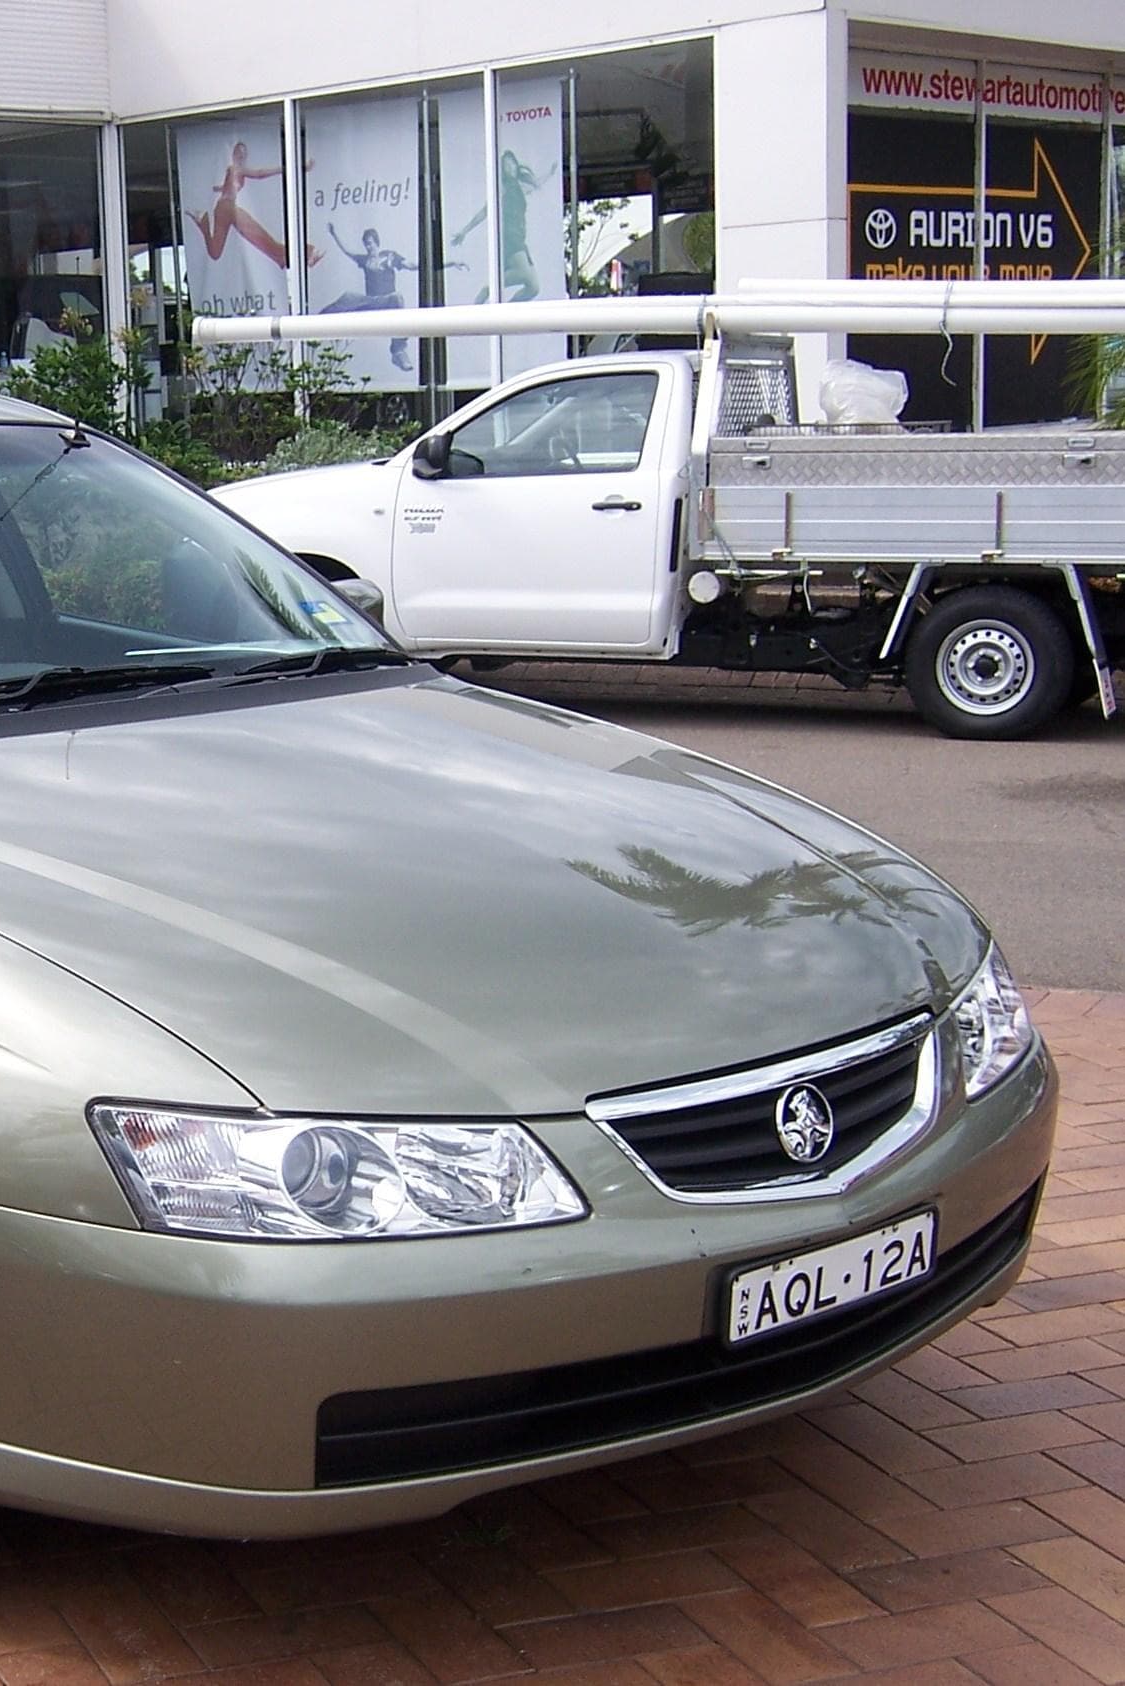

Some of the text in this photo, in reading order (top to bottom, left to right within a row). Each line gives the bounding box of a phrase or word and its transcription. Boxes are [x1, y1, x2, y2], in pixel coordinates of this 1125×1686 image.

[862, 66, 1125, 114] www.stewartautomotie
[506, 106, 552, 122] TOYOTA
[314, 177, 410, 211] a feeling!
[1019, 213, 1053, 248] V6
[865, 257, 926, 281] make
[201, 290, 277, 318] oh what
[737, 1287, 751, 1336] NSW
